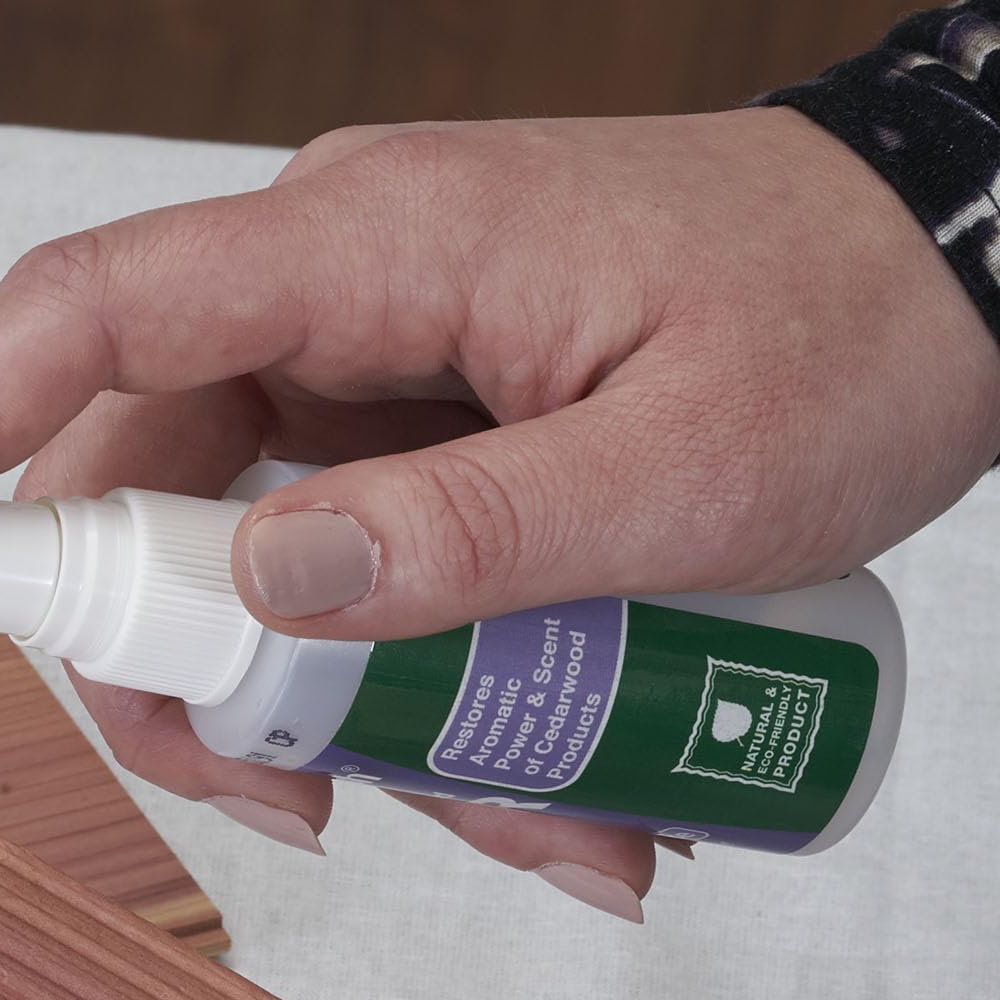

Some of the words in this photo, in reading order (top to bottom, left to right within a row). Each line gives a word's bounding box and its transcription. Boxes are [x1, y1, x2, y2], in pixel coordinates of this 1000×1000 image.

[533, 617, 561, 684] Scent
[534, 630, 586, 755] Cedarwood
[441, 674, 495, 761] Restores
[469, 677, 522, 766] Aromatic
[494, 713, 537, 770] Power
[527, 692, 547, 708] &
[546, 693, 601, 780] Products
[740, 702, 774, 772] NATURAL
[765, 686, 778, 698] &
[757, 685, 793, 774] ECO-FRIENDLY
[772, 689, 811, 778] PRODUCT
[524, 756, 545, 775] of
